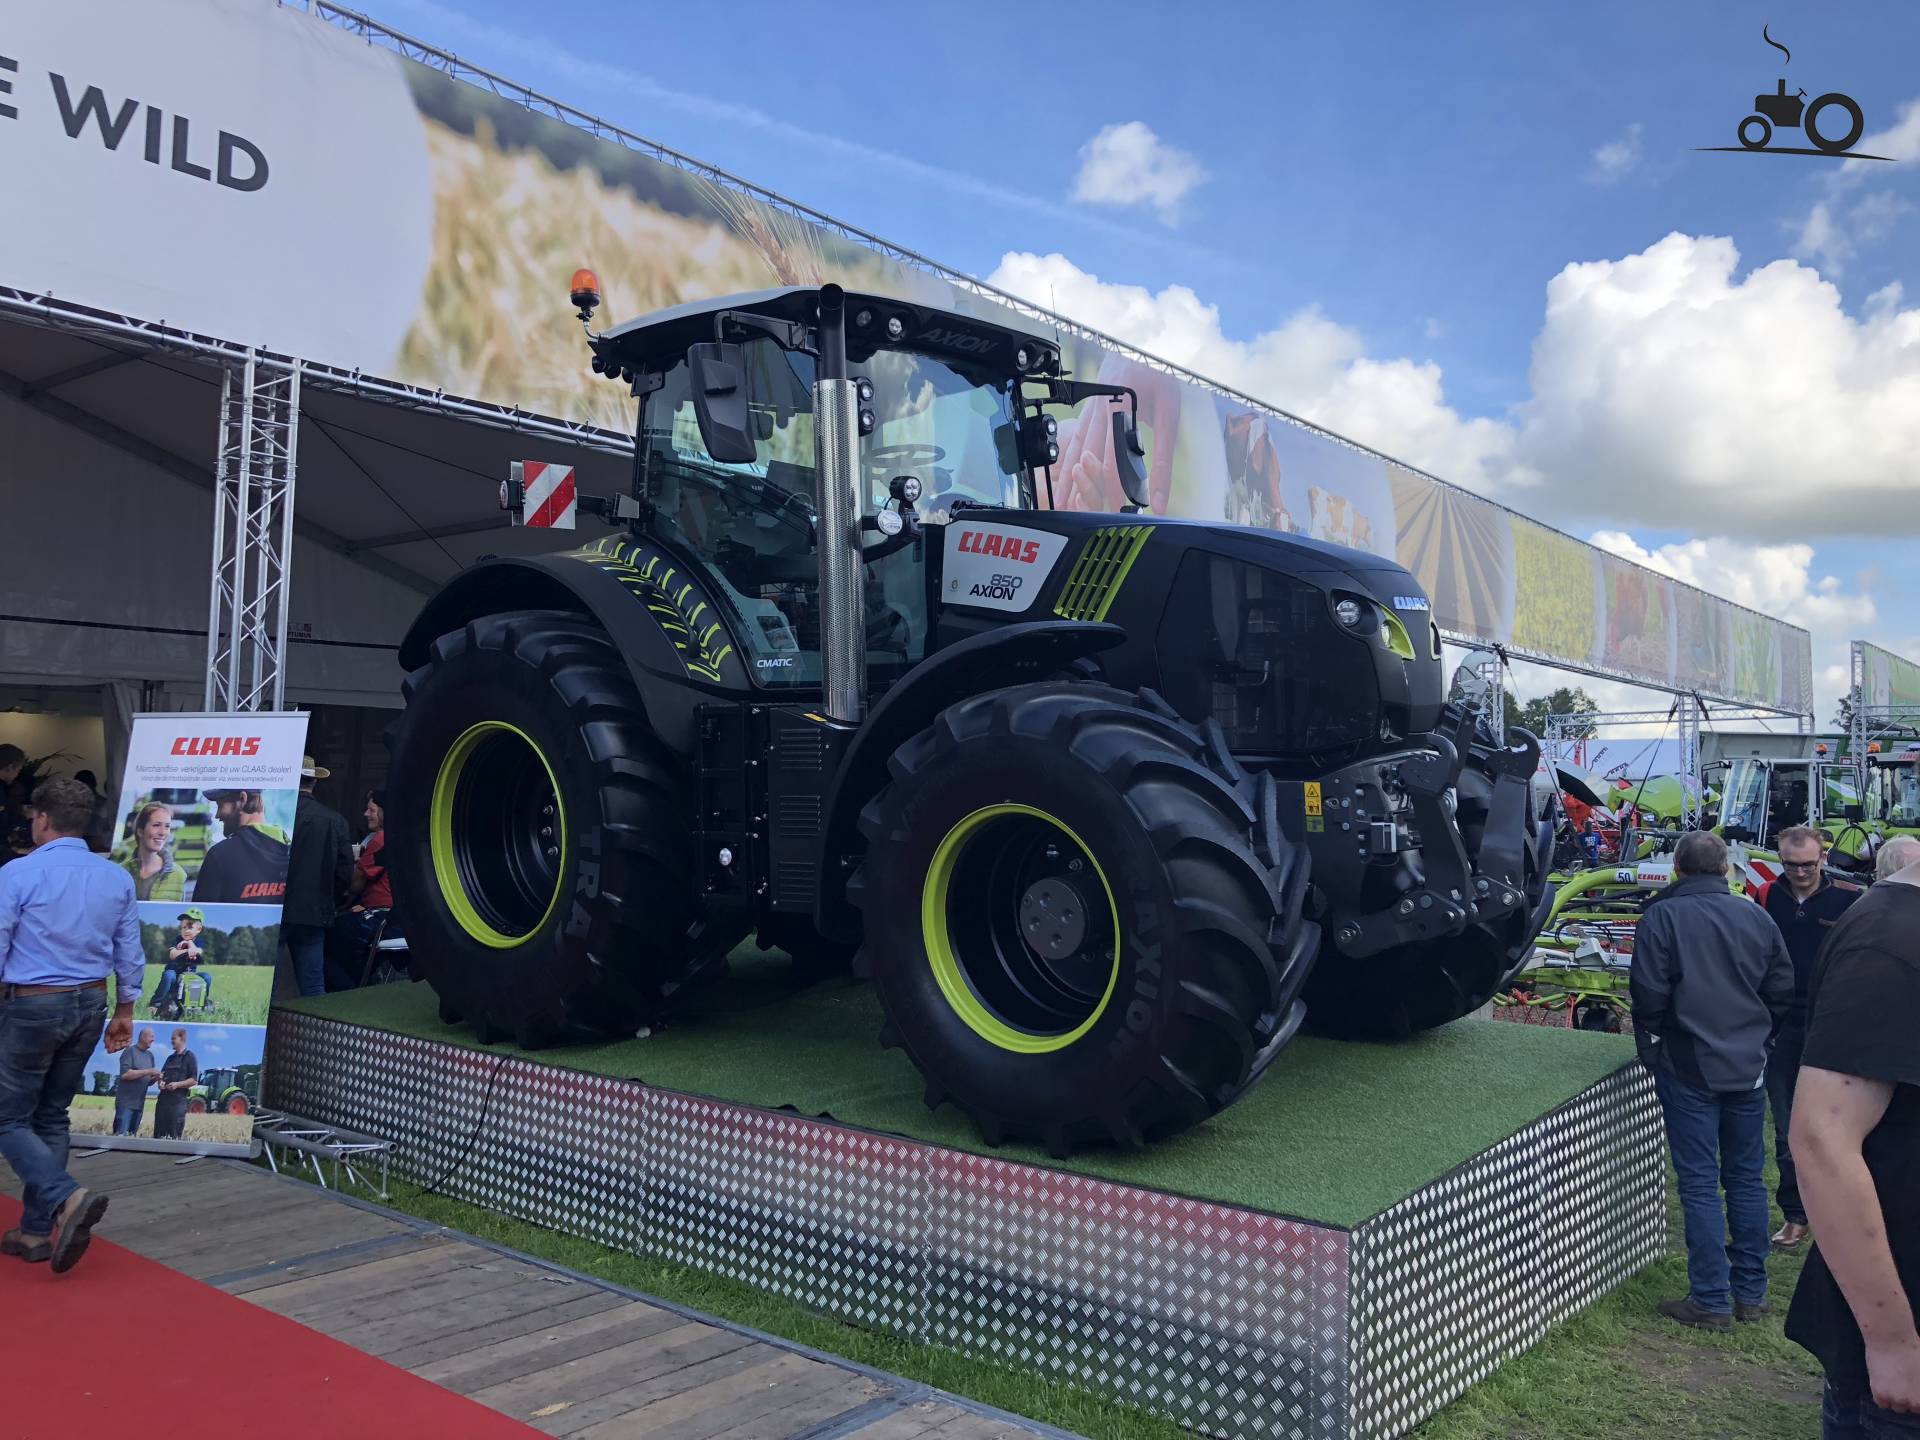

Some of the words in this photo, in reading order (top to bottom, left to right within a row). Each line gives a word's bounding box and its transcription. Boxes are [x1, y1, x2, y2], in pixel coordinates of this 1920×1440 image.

[48, 71, 269, 192] WILD
[917, 328, 999, 353] AXION
[958, 531, 1040, 564] CLAAS
[990, 573, 1023, 589] 850
[969, 583, 1015, 601] AXION
[1393, 596, 1429, 611] CLAAS
[757, 658, 793, 668] CMATIC
[170, 737, 261, 756] CLAAS
[241, 764, 267, 773] CLAAS
[1618, 872, 1631, 883] 50
[1637, 873, 1667, 881] CLAAS
[240, 882, 287, 899] CLAAS
